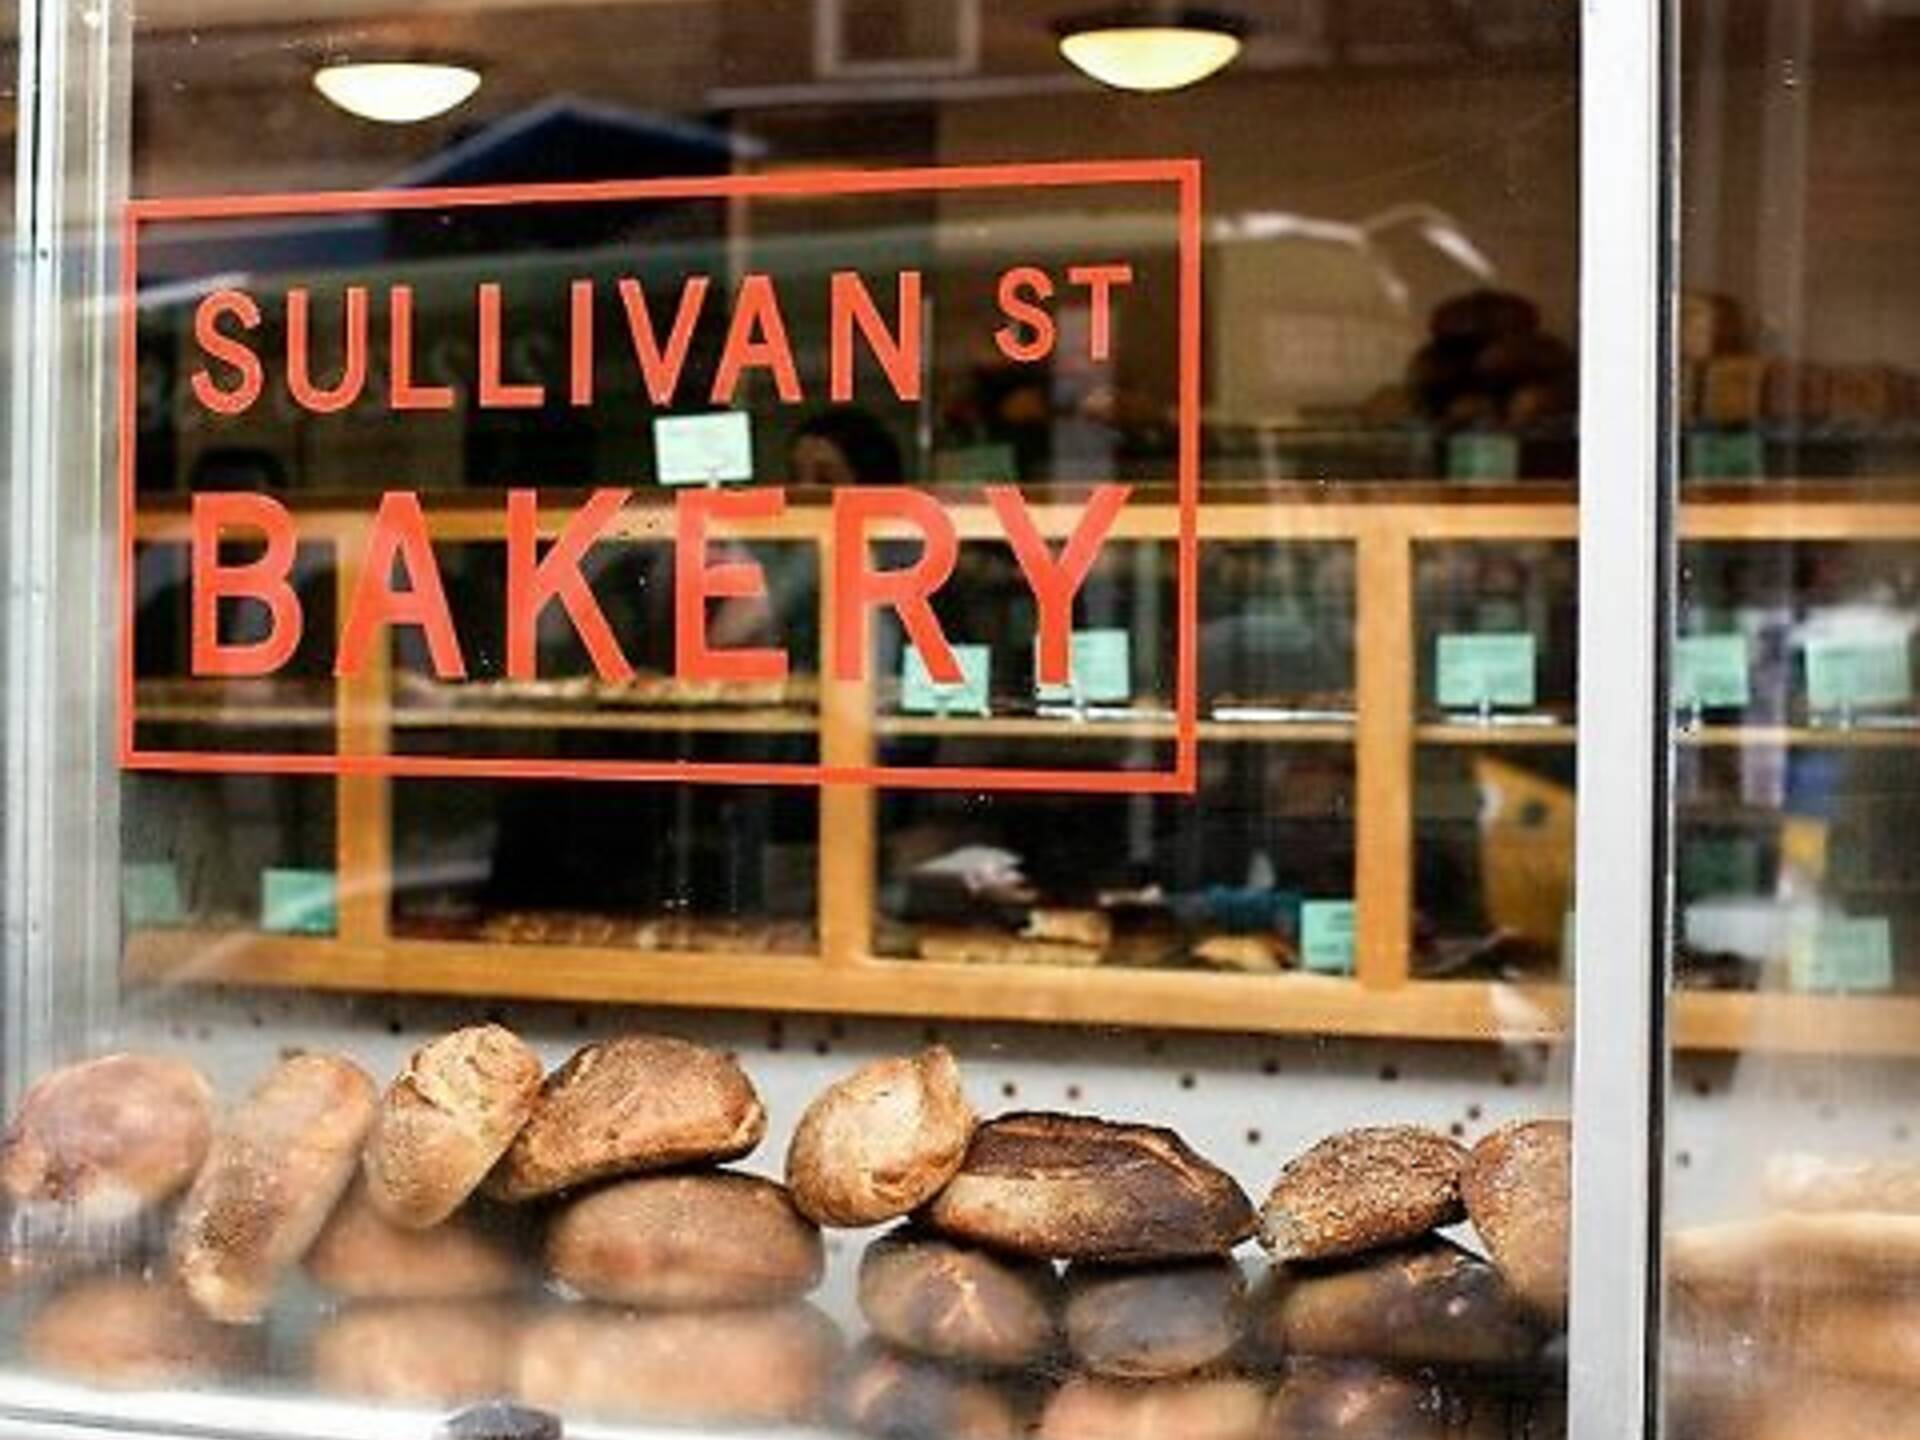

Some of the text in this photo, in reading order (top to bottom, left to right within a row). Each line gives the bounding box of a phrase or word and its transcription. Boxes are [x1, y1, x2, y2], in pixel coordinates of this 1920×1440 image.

[191, 265, 1132, 414] SULLIVAN ST
[189, 485, 1133, 684] BAKERY
